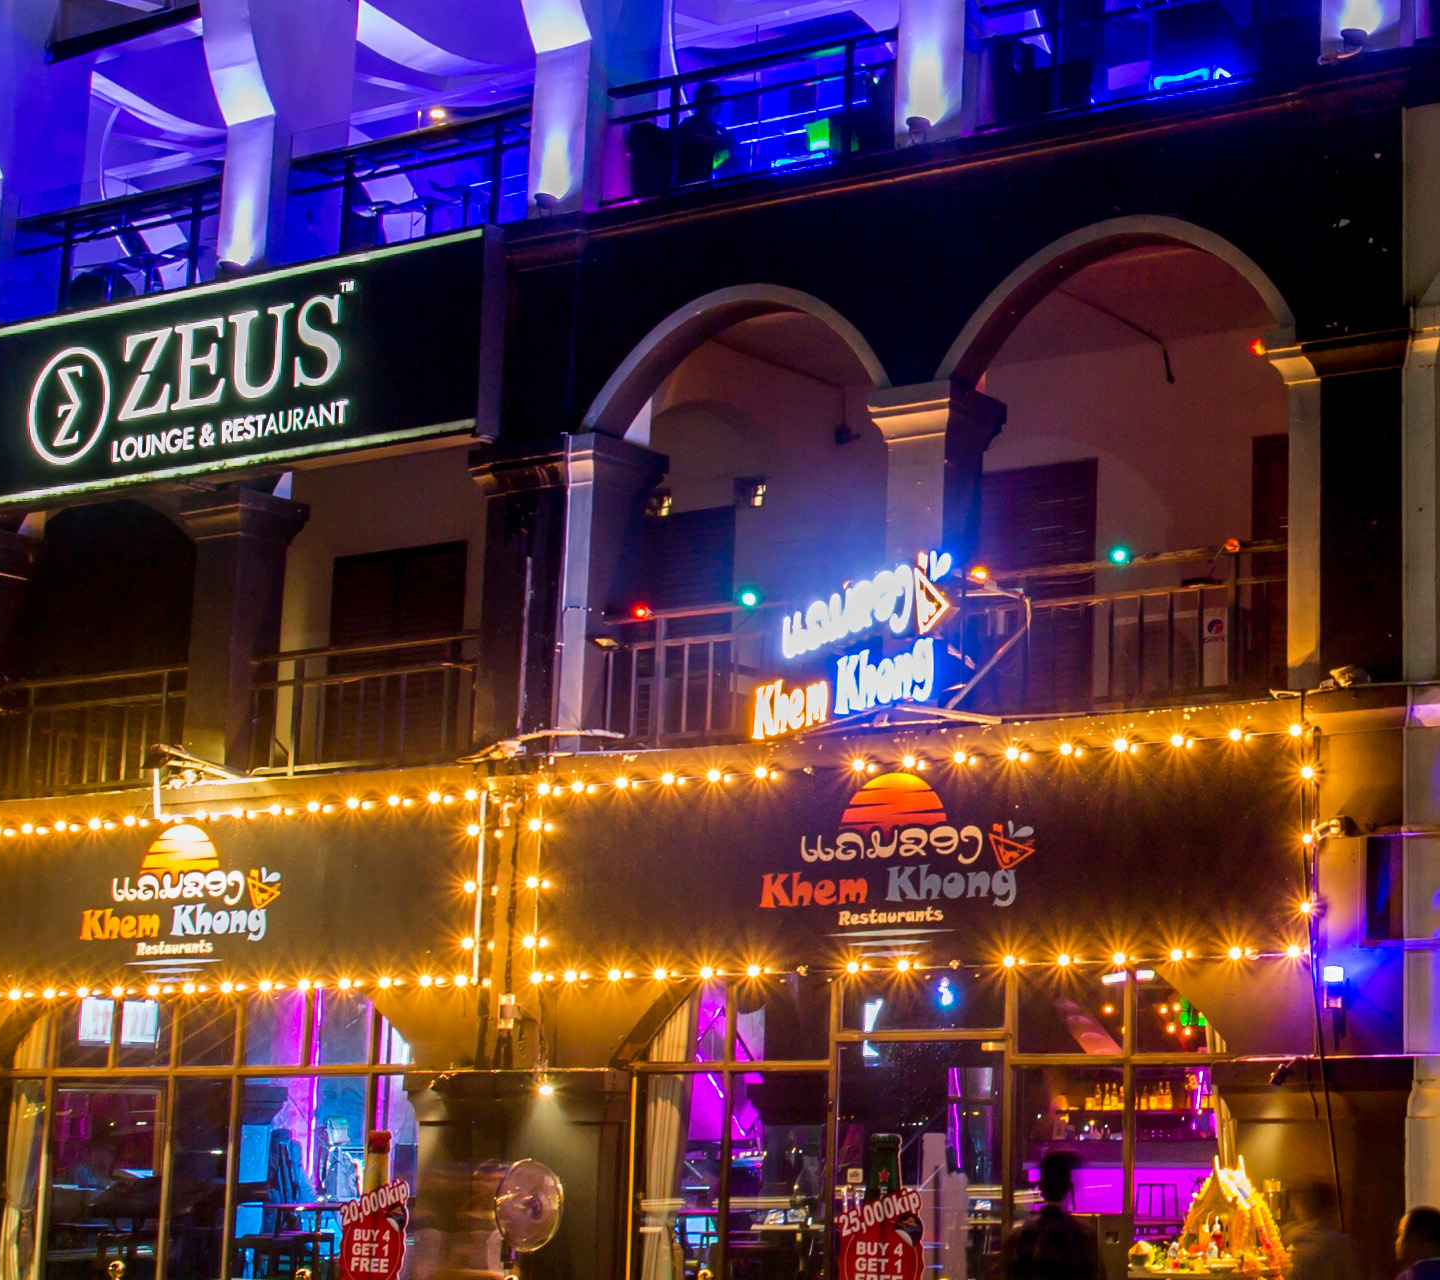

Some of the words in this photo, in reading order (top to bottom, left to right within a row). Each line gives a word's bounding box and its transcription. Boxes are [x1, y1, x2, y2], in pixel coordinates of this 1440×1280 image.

[118, 294, 342, 421] ZEUS
[112, 426, 194, 463] LOUNGE
[199, 422, 215, 448] &
[221, 399, 349, 444] RESTAURANT
[751, 679, 828, 740] Khem
[834, 637, 934, 715] Khong
[759, 871, 868, 908] Khem
[885, 863, 1017, 907] Khong
[79, 908, 160, 941] Khem
[169, 903, 267, 942] Khong
[838, 906, 944, 926] Restaurants
[135, 939, 214, 956] Restaurants
[341, 1179, 408, 1226] 20,000kip
[839, 1190, 921, 1237] 25,000kip
[352, 1242, 379, 1256] GET
[382, 1243, 389, 1257] 1
[353, 1228, 380, 1242] BUY
[382, 1229, 391, 1242] 4
[855, 1240, 889, 1256] BUY
[893, 1242, 903, 1257] 4
[350, 1257, 389, 1273] FREE
[854, 1257, 889, 1273] GET
[893, 1258, 902, 1274] 1
